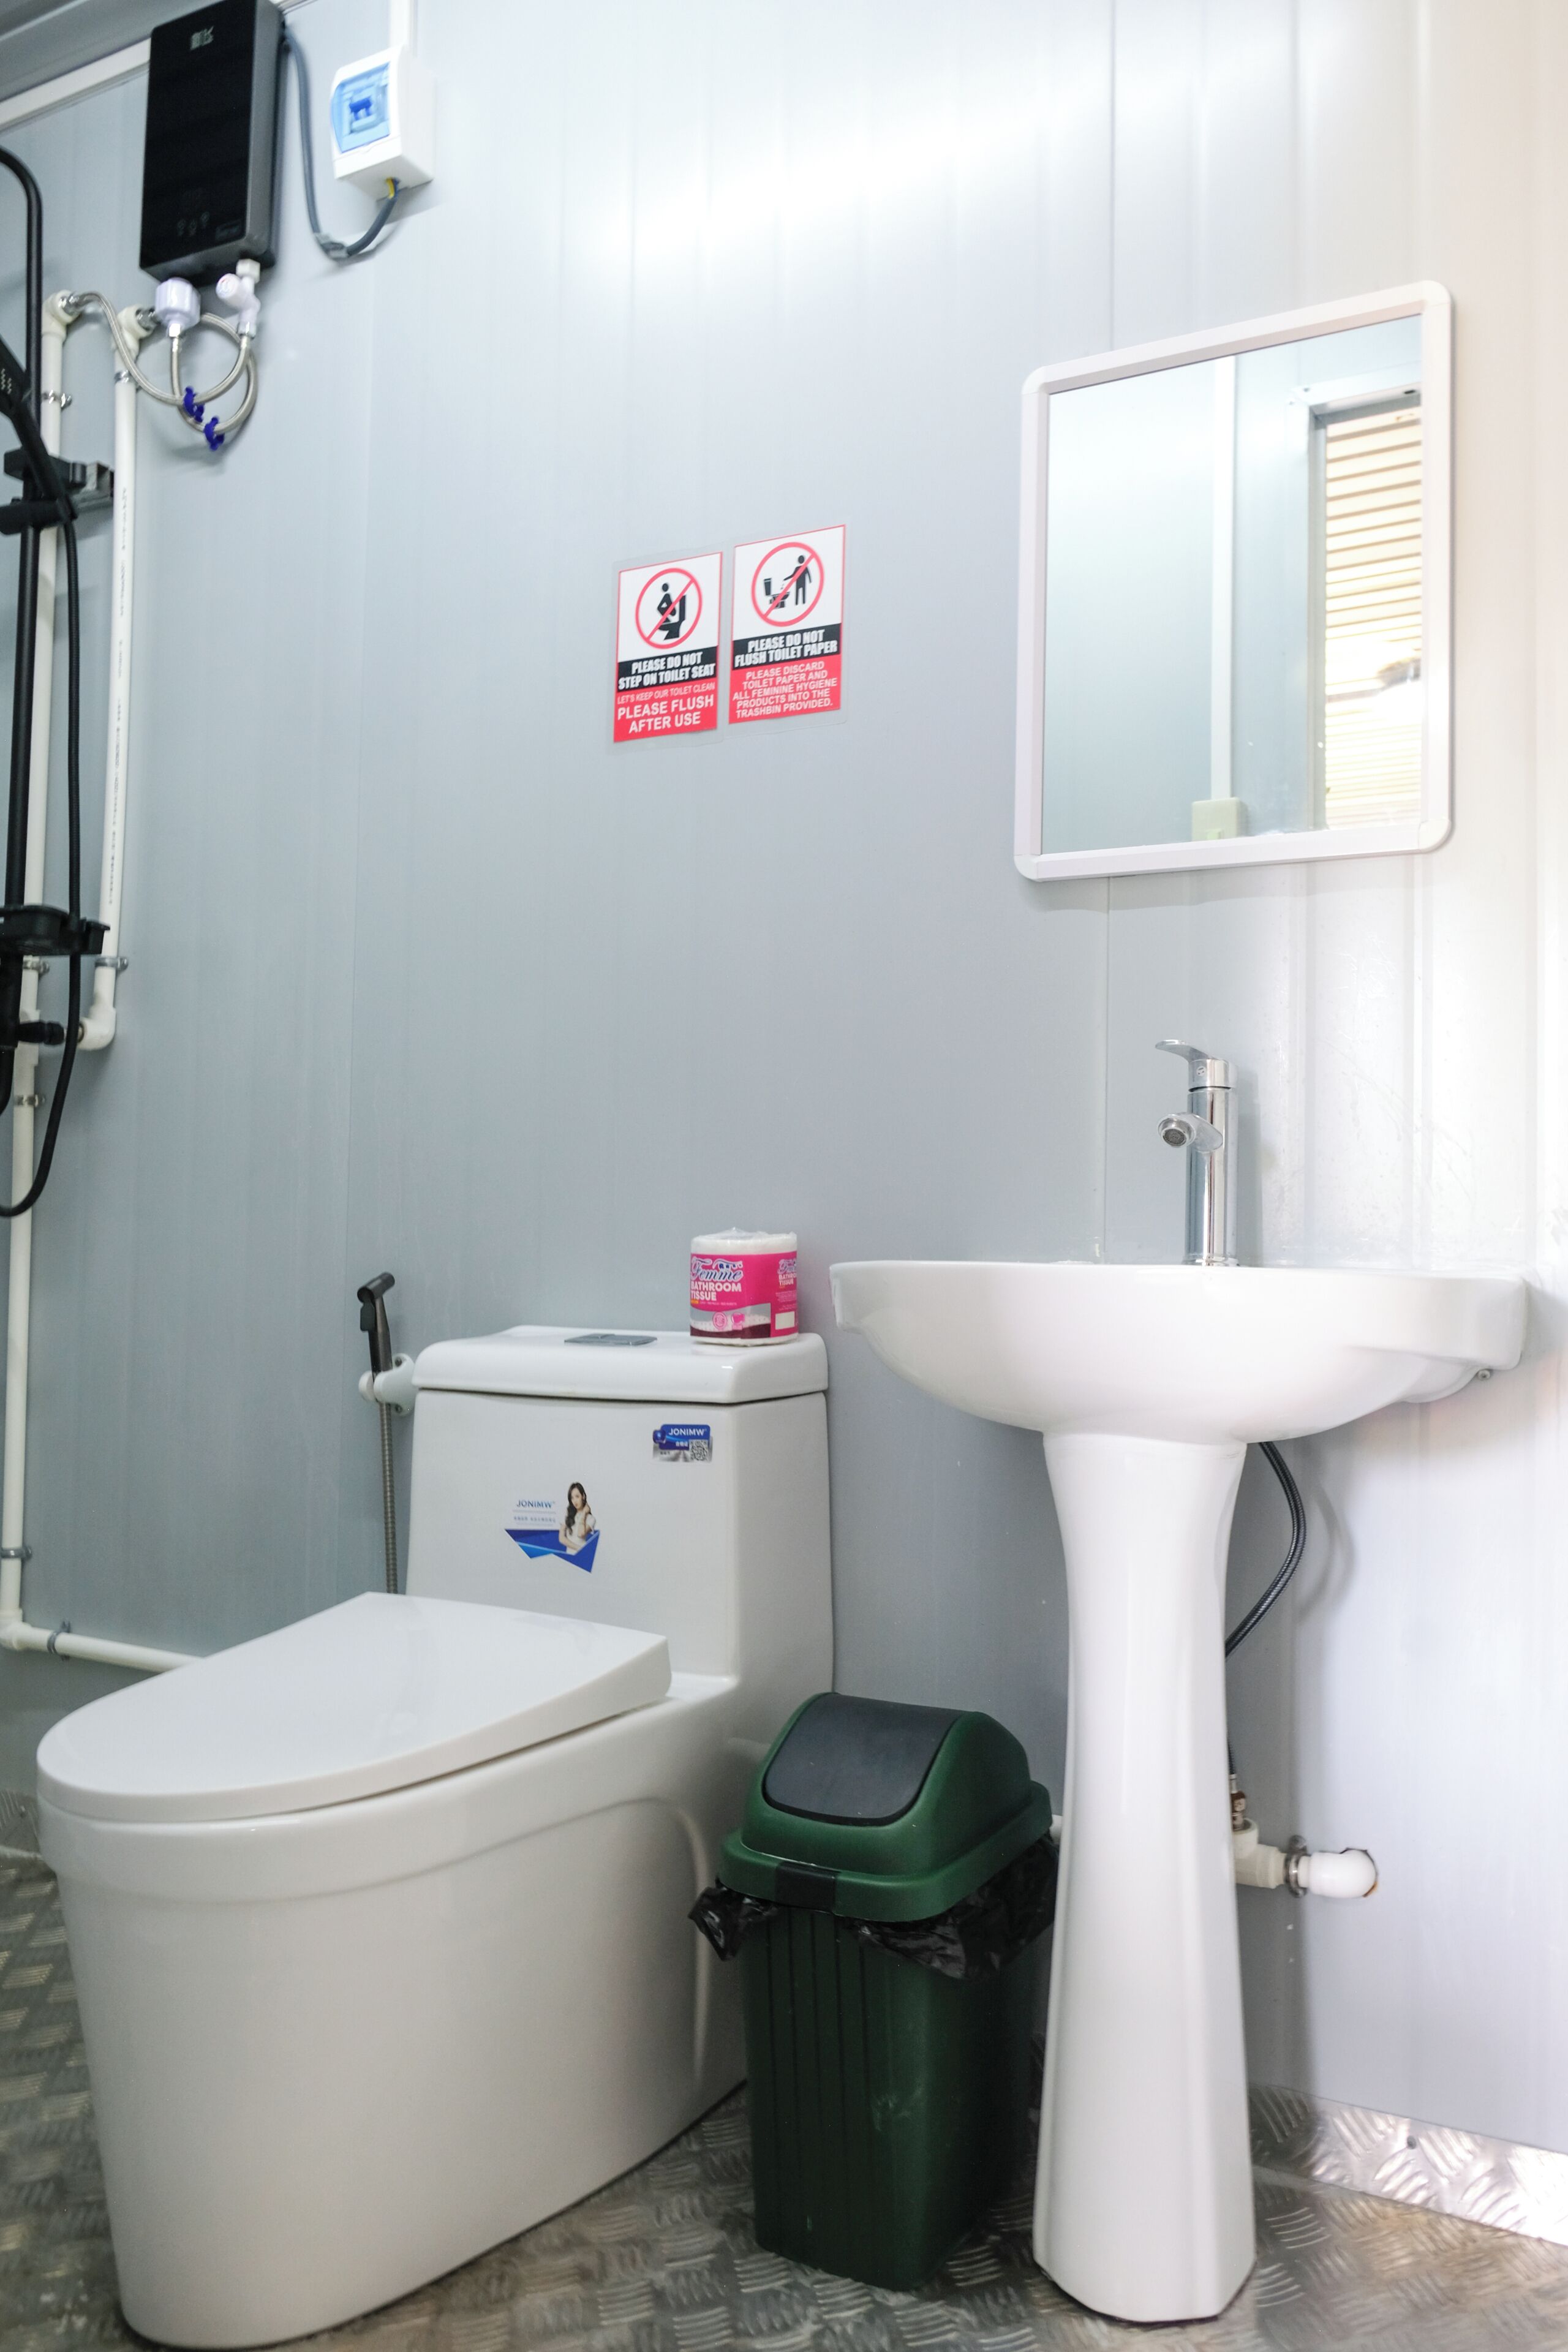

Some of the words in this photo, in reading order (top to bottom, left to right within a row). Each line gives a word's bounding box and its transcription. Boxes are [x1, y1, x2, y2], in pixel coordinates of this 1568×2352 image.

[748, 636, 785, 653] PLEASE
[785, 633, 801, 647] DO
[802, 629, 825, 644] NOT
[631, 658, 666, 674] PLEASE
[666, 655, 681, 669] DO
[682, 652, 703, 666] NOT
[734, 653, 766, 668] FLUSH
[767, 646, 803, 662] TOILET
[804, 640, 837, 657] PAPER
[618, 675, 643, 690] STEP
[643, 672, 657, 687] ON
[658, 668, 691, 684] TOILET
[692, 663, 715, 679] SEAT
[742, 678, 775, 690] TOILET
[775, 674, 806, 685] PAPER
[807, 670, 827, 681] AND
[746, 668, 782, 680] PLEASE
[783, 661, 824, 675] DISCARD
[617, 694, 635, 704] LET'S
[636, 692, 654, 702] KEEP
[654, 689, 669, 699] OUR
[670, 685, 692, 696] TOILET
[693, 682, 715, 693] CLEAN
[733, 691, 750, 701] ALL
[752, 684, 794, 698] FEMININE
[796, 678, 837, 692] HYGIENE
[736, 695, 786, 709] PRODUCTS
[788, 692, 810, 703] INTO
[812, 688, 831, 698] THE
[618, 701, 668, 720] PLEASE
[671, 694, 714, 712] FLUSH
[736, 705, 782, 719] TRASHBIN
[783, 698, 833, 712] PROVIDED.
[628, 716, 671, 734] AFTER
[675, 712, 701, 727] USE
[691, 1281, 742, 1292] BATHROOM
[691, 1291, 717, 1301] TISSUE
